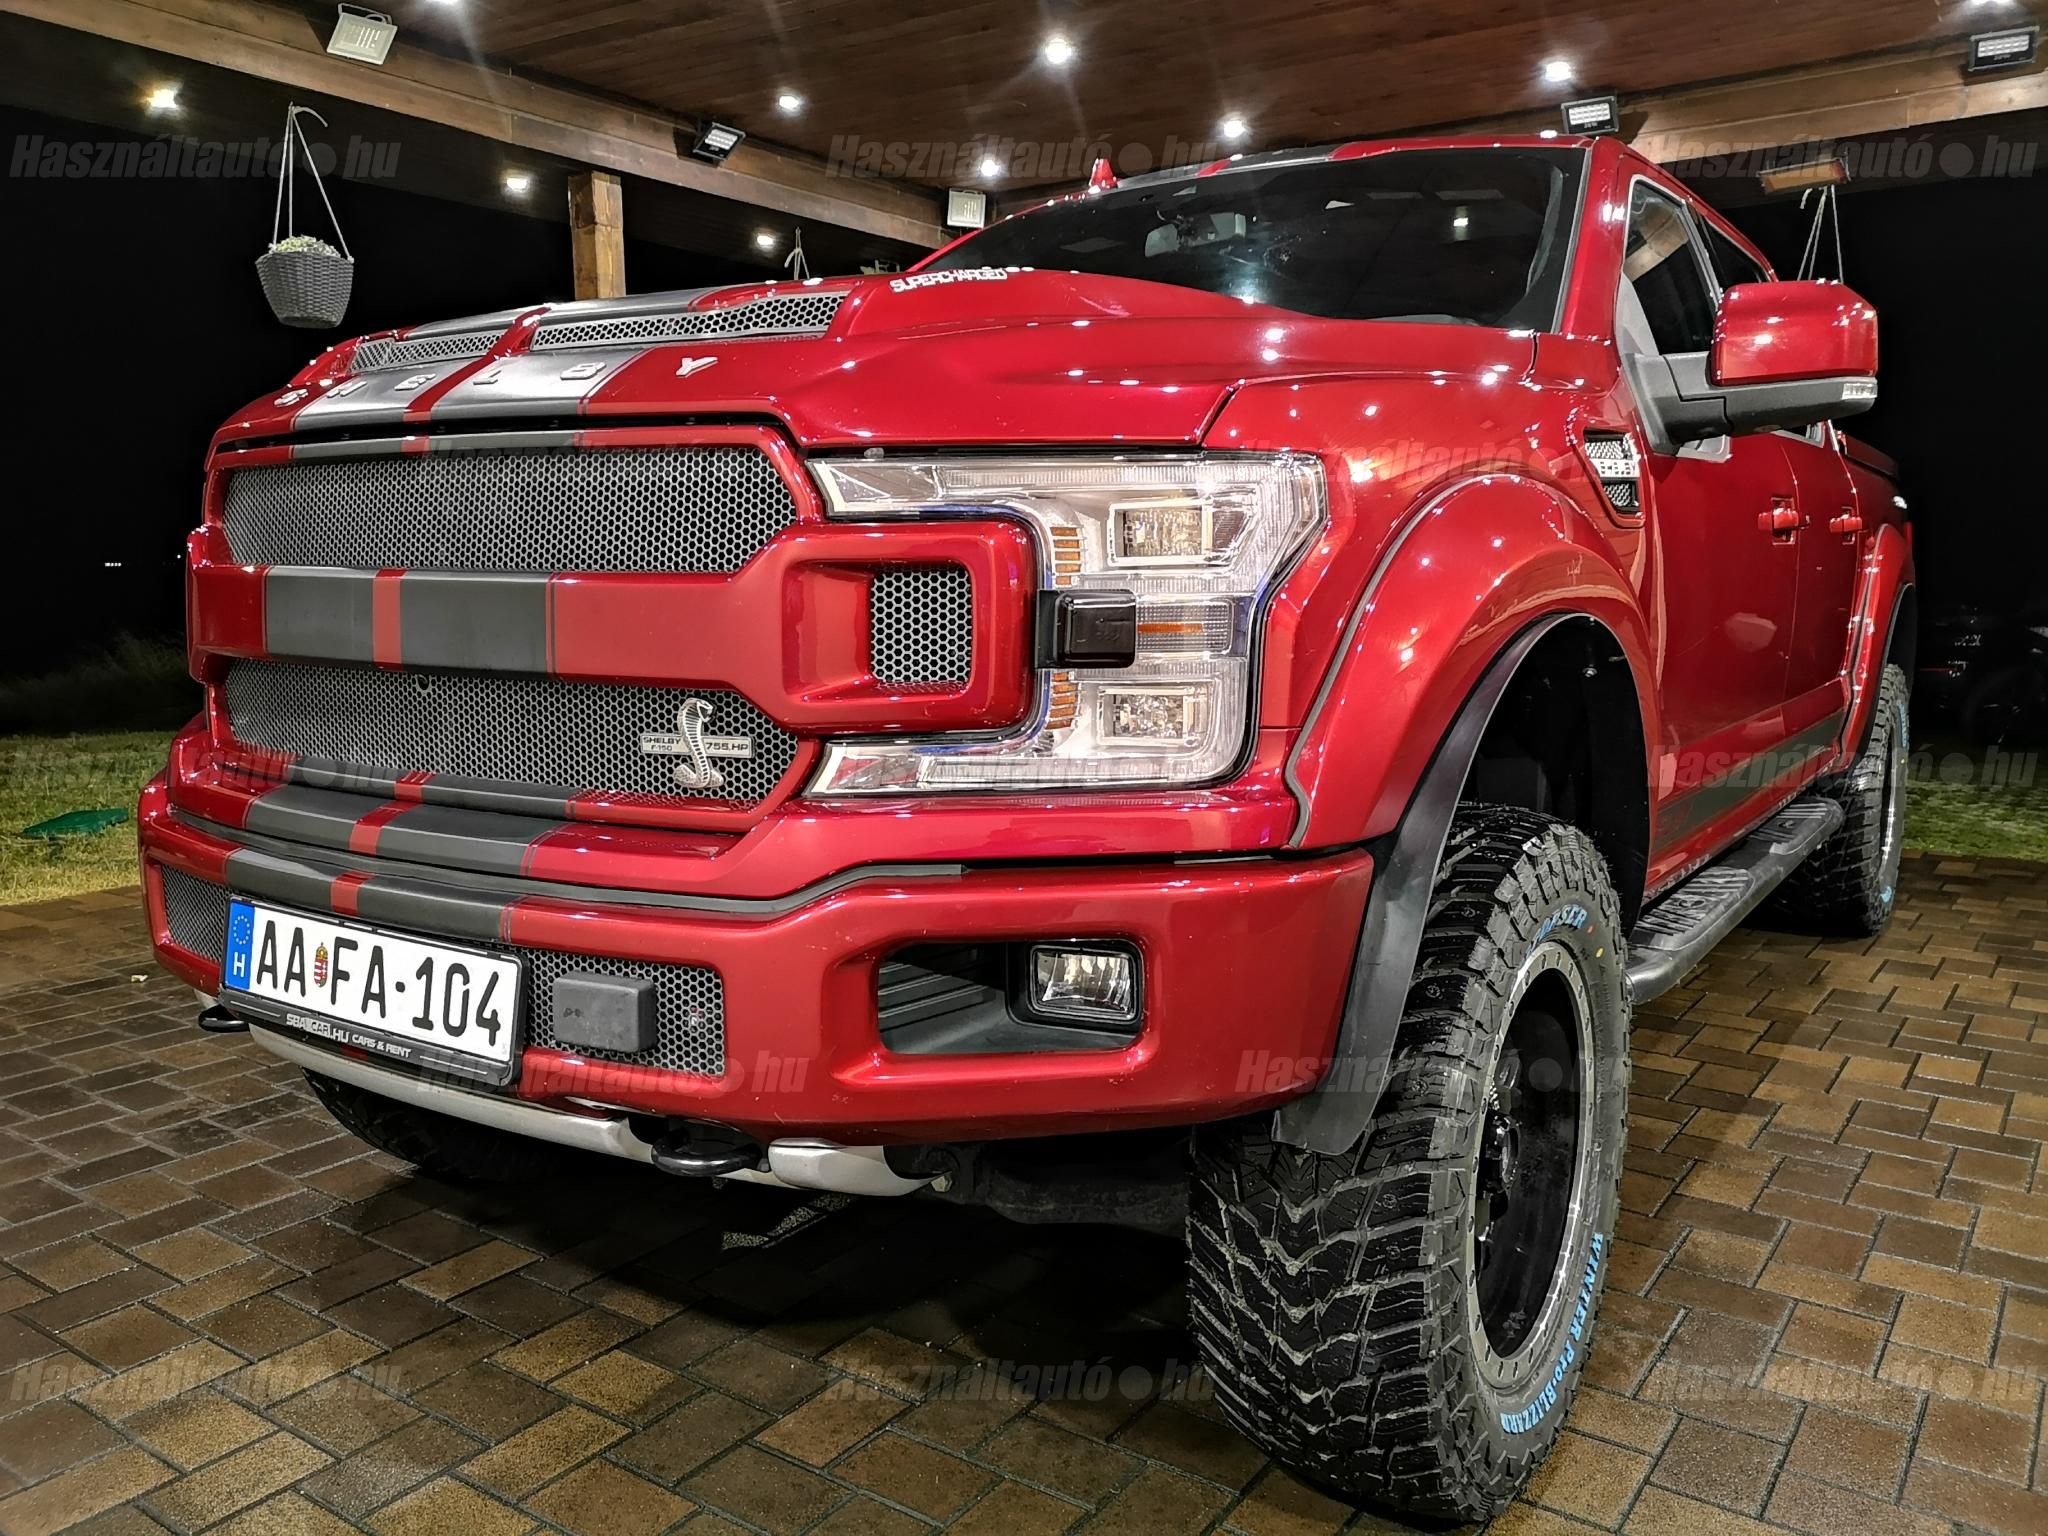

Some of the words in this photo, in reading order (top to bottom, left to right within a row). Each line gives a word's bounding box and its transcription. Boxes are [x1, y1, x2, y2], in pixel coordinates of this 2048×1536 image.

[890, 267, 1007, 292] SUPERCHARGED
[233, 953, 246, 978] H
[352, 1034, 377, 1047] CARS
[376, 1041, 385, 1050] &
[386, 1043, 412, 1058] RENT
[1568, 1232, 1603, 1342] WINTER
